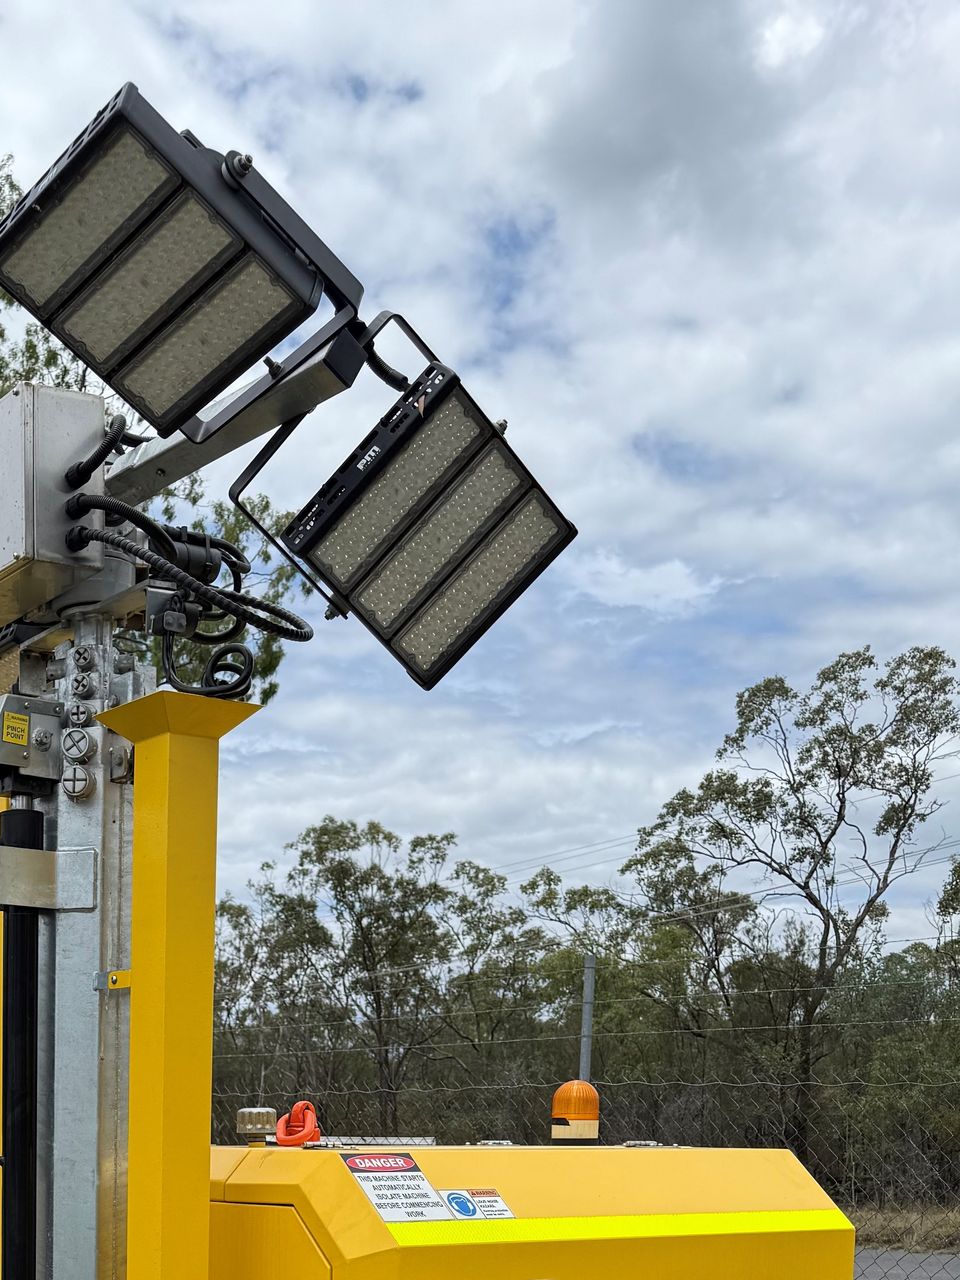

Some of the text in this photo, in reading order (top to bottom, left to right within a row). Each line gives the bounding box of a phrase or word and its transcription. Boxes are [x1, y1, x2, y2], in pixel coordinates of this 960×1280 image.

[6, 725, 26, 733] PINCH
[6, 732, 24, 740] POINT
[354, 1158, 407, 1168] DANGER
[401, 1201, 444, 1209] COMMENCING
